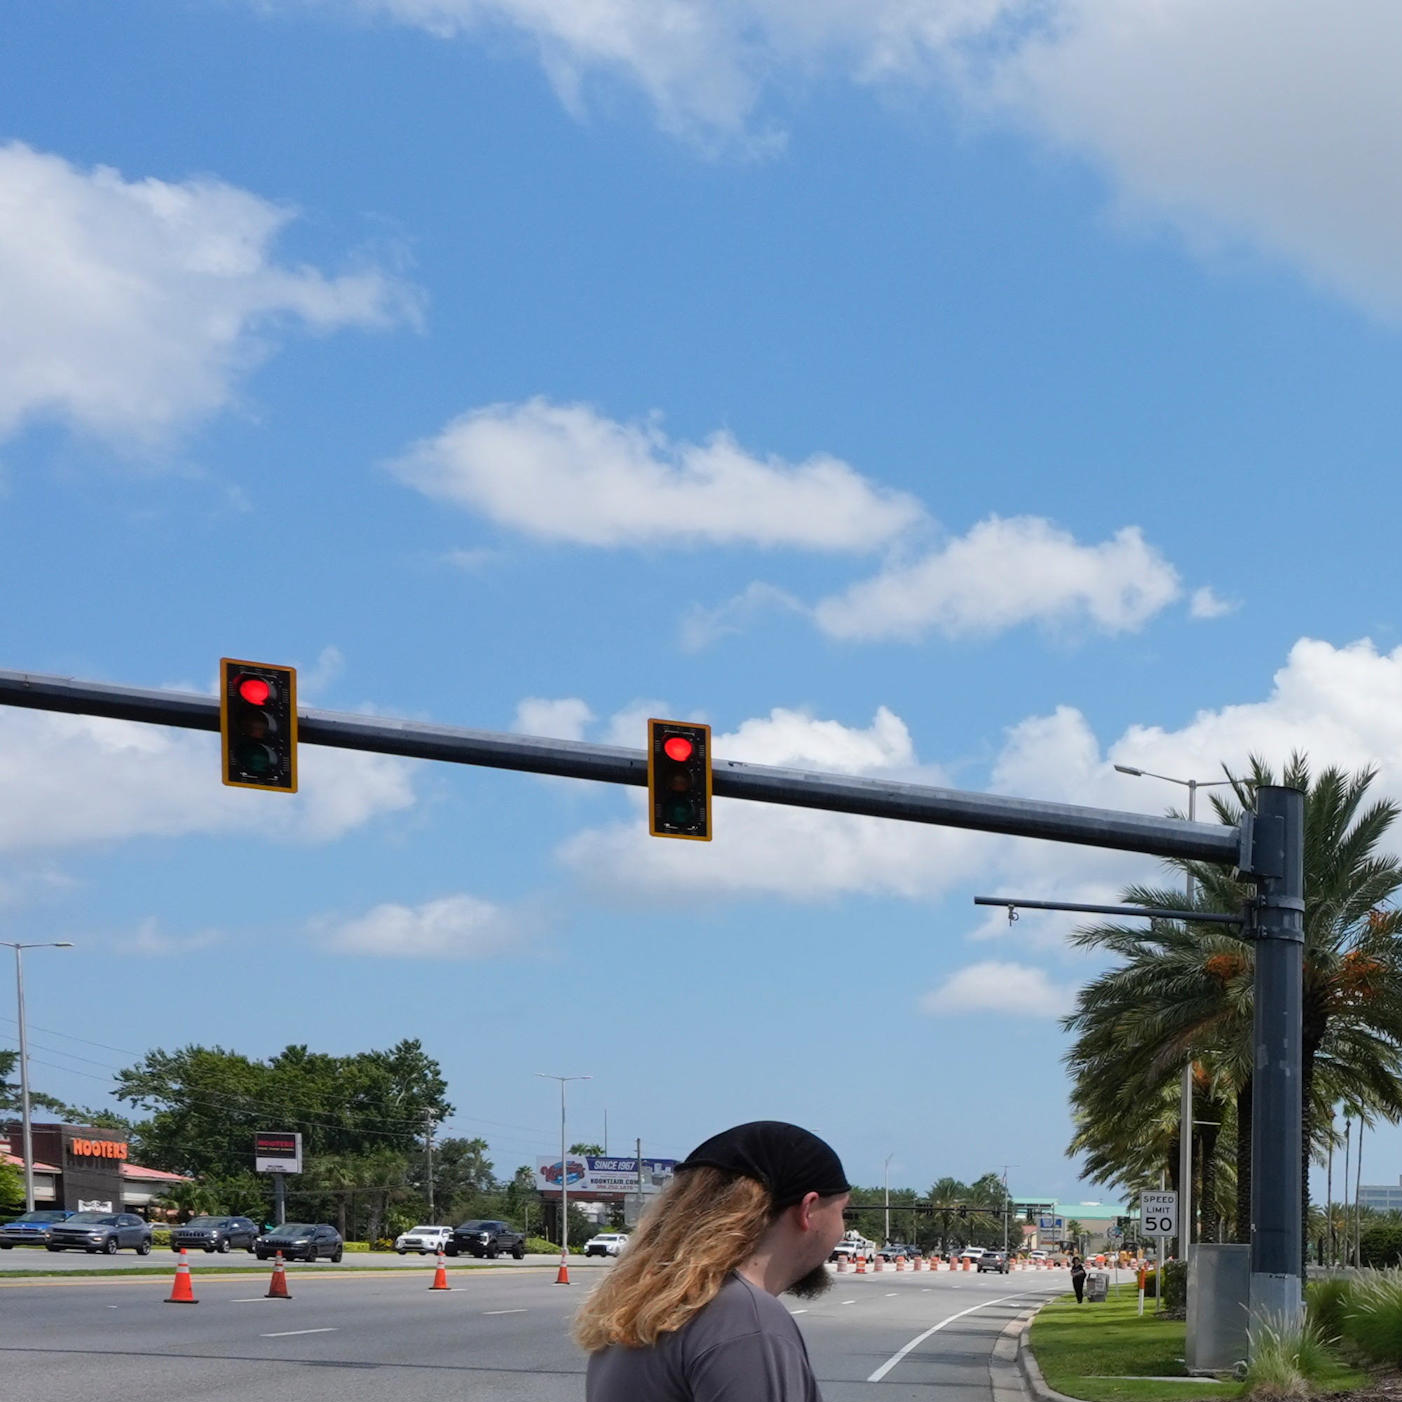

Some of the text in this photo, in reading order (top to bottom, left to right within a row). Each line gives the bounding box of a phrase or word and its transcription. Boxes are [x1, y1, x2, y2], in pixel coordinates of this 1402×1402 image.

[73, 1138, 128, 1160] HOOTERS
[593, 1160, 635, 1171] SINCE 1967
[1143, 1195, 1174, 1204] SPEED
[1146, 1206, 1170, 1214] LIMIT
[1145, 1217, 1172, 1232] 50
